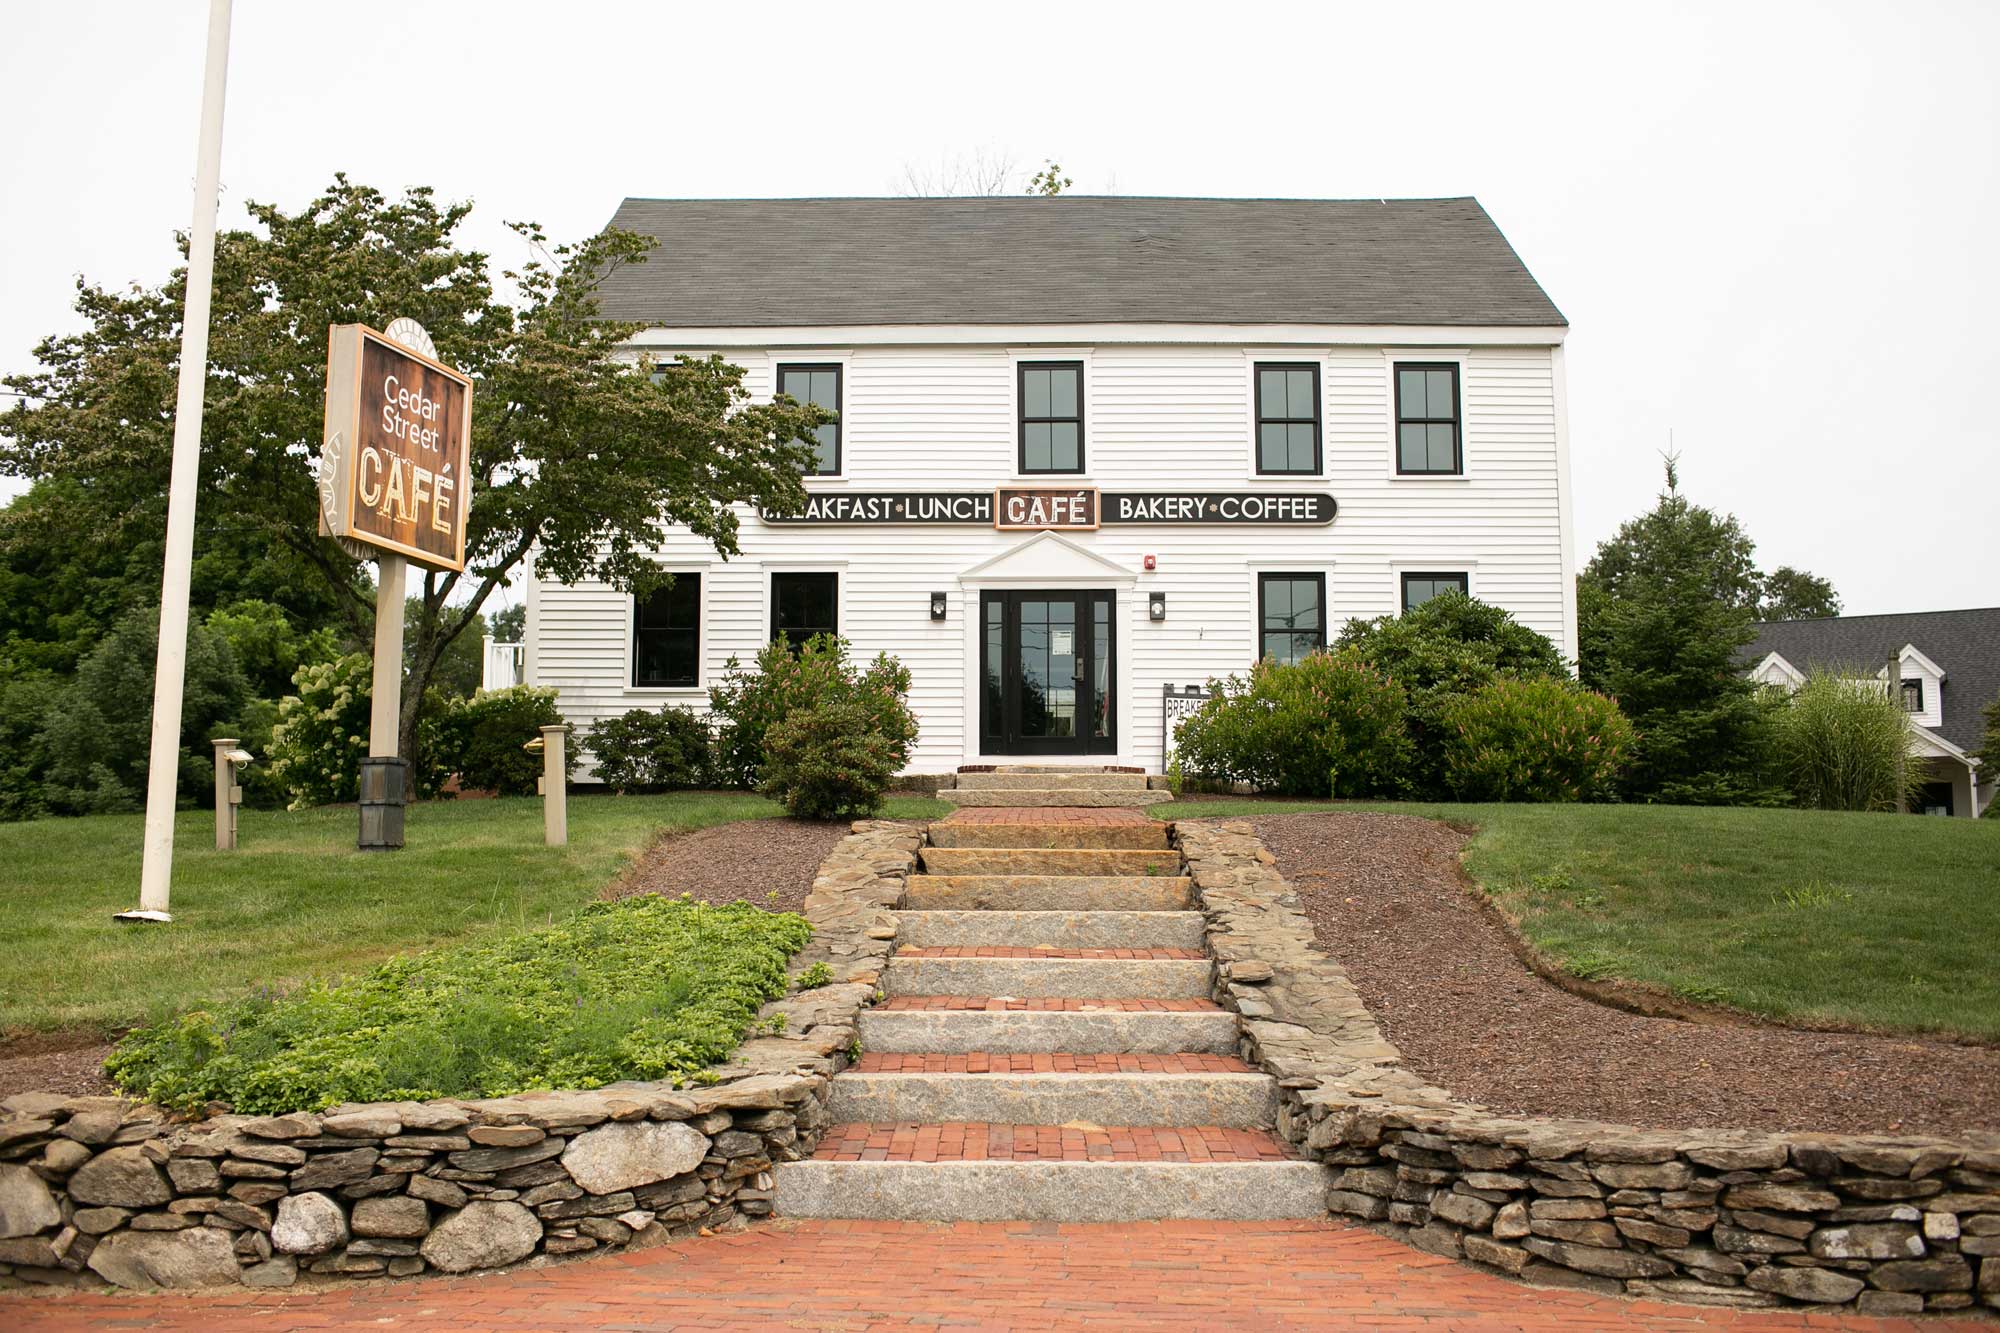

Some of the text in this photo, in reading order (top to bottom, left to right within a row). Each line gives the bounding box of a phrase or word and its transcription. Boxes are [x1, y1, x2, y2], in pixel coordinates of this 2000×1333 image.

[384, 375, 440, 422] Cedar
[382, 405, 439, 452] Street
[359, 447, 453, 535] CAFÉ
[763, 498, 990, 519] AKFAST LUNCH
[1008, 491, 1086, 524] CAFÉ
[1120, 497, 1318, 519] BAKERY COFFEE
